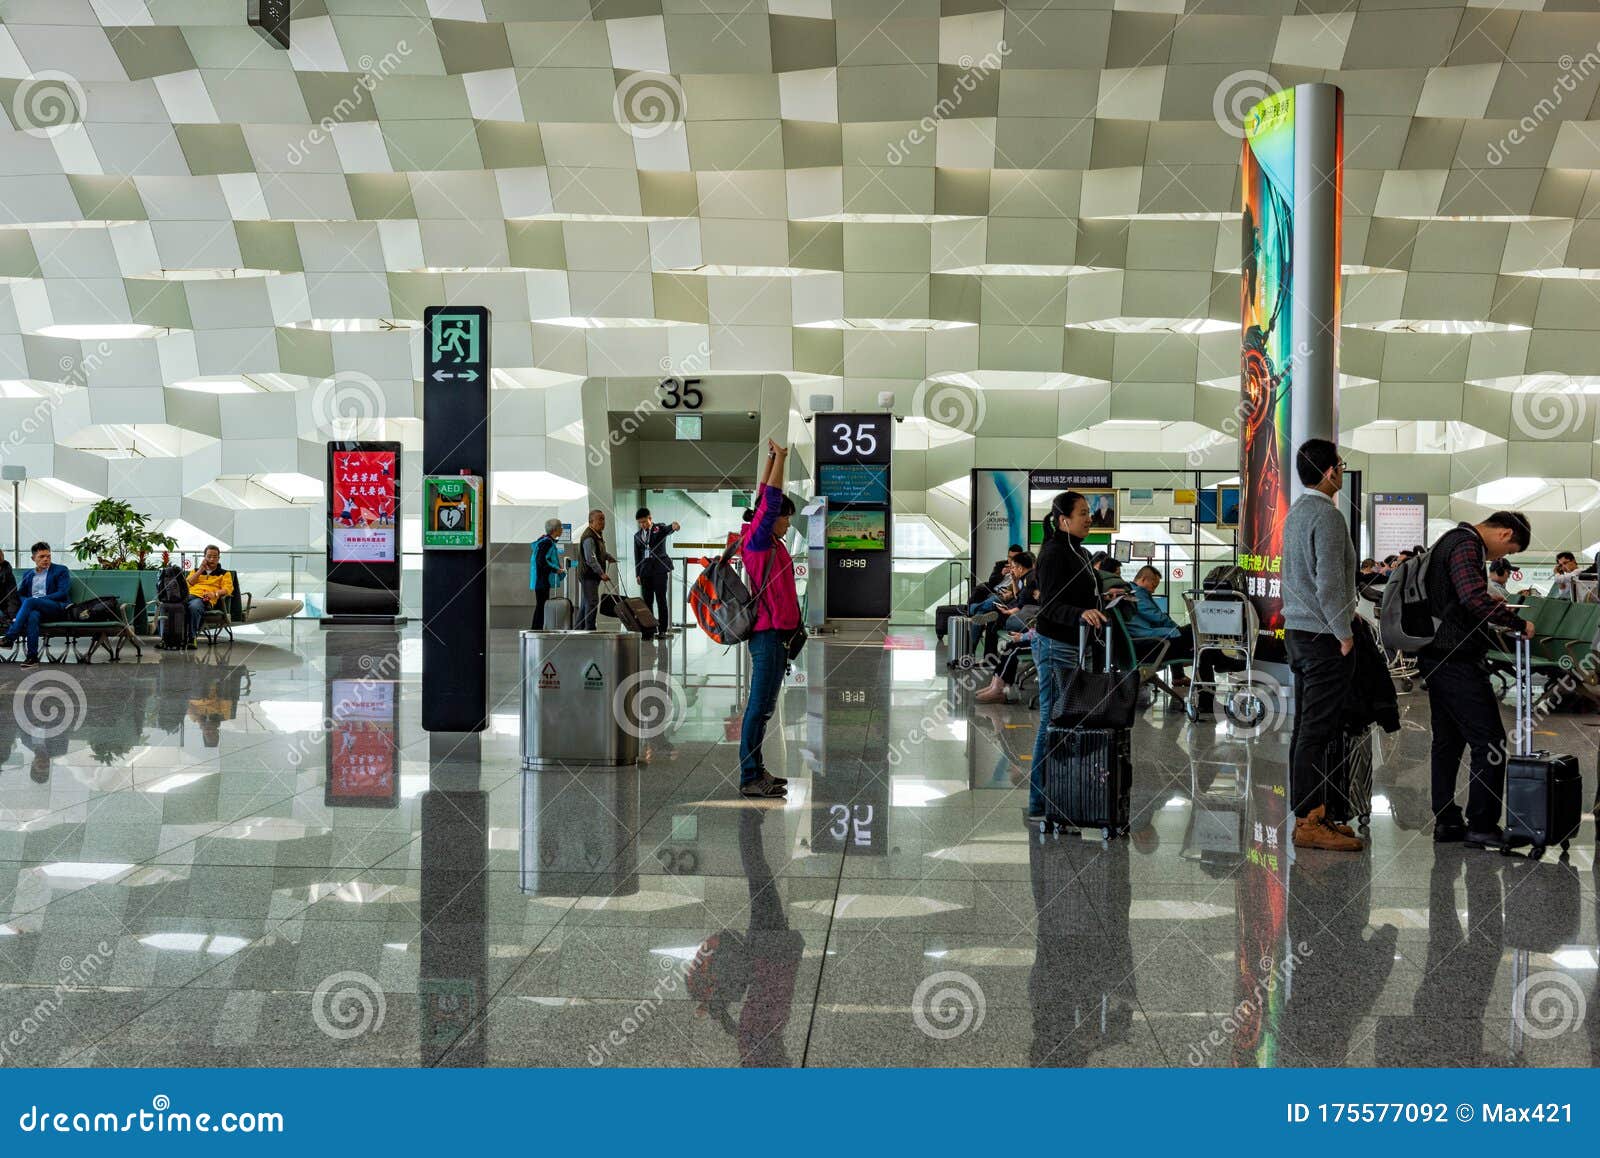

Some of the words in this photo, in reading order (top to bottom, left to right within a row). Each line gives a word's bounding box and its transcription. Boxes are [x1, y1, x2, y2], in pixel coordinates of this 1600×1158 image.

[660, 378, 703, 410] 35
[832, 423, 877, 455] 35
[441, 484, 460, 492] AED
[839, 558, 867, 568] 13:49
